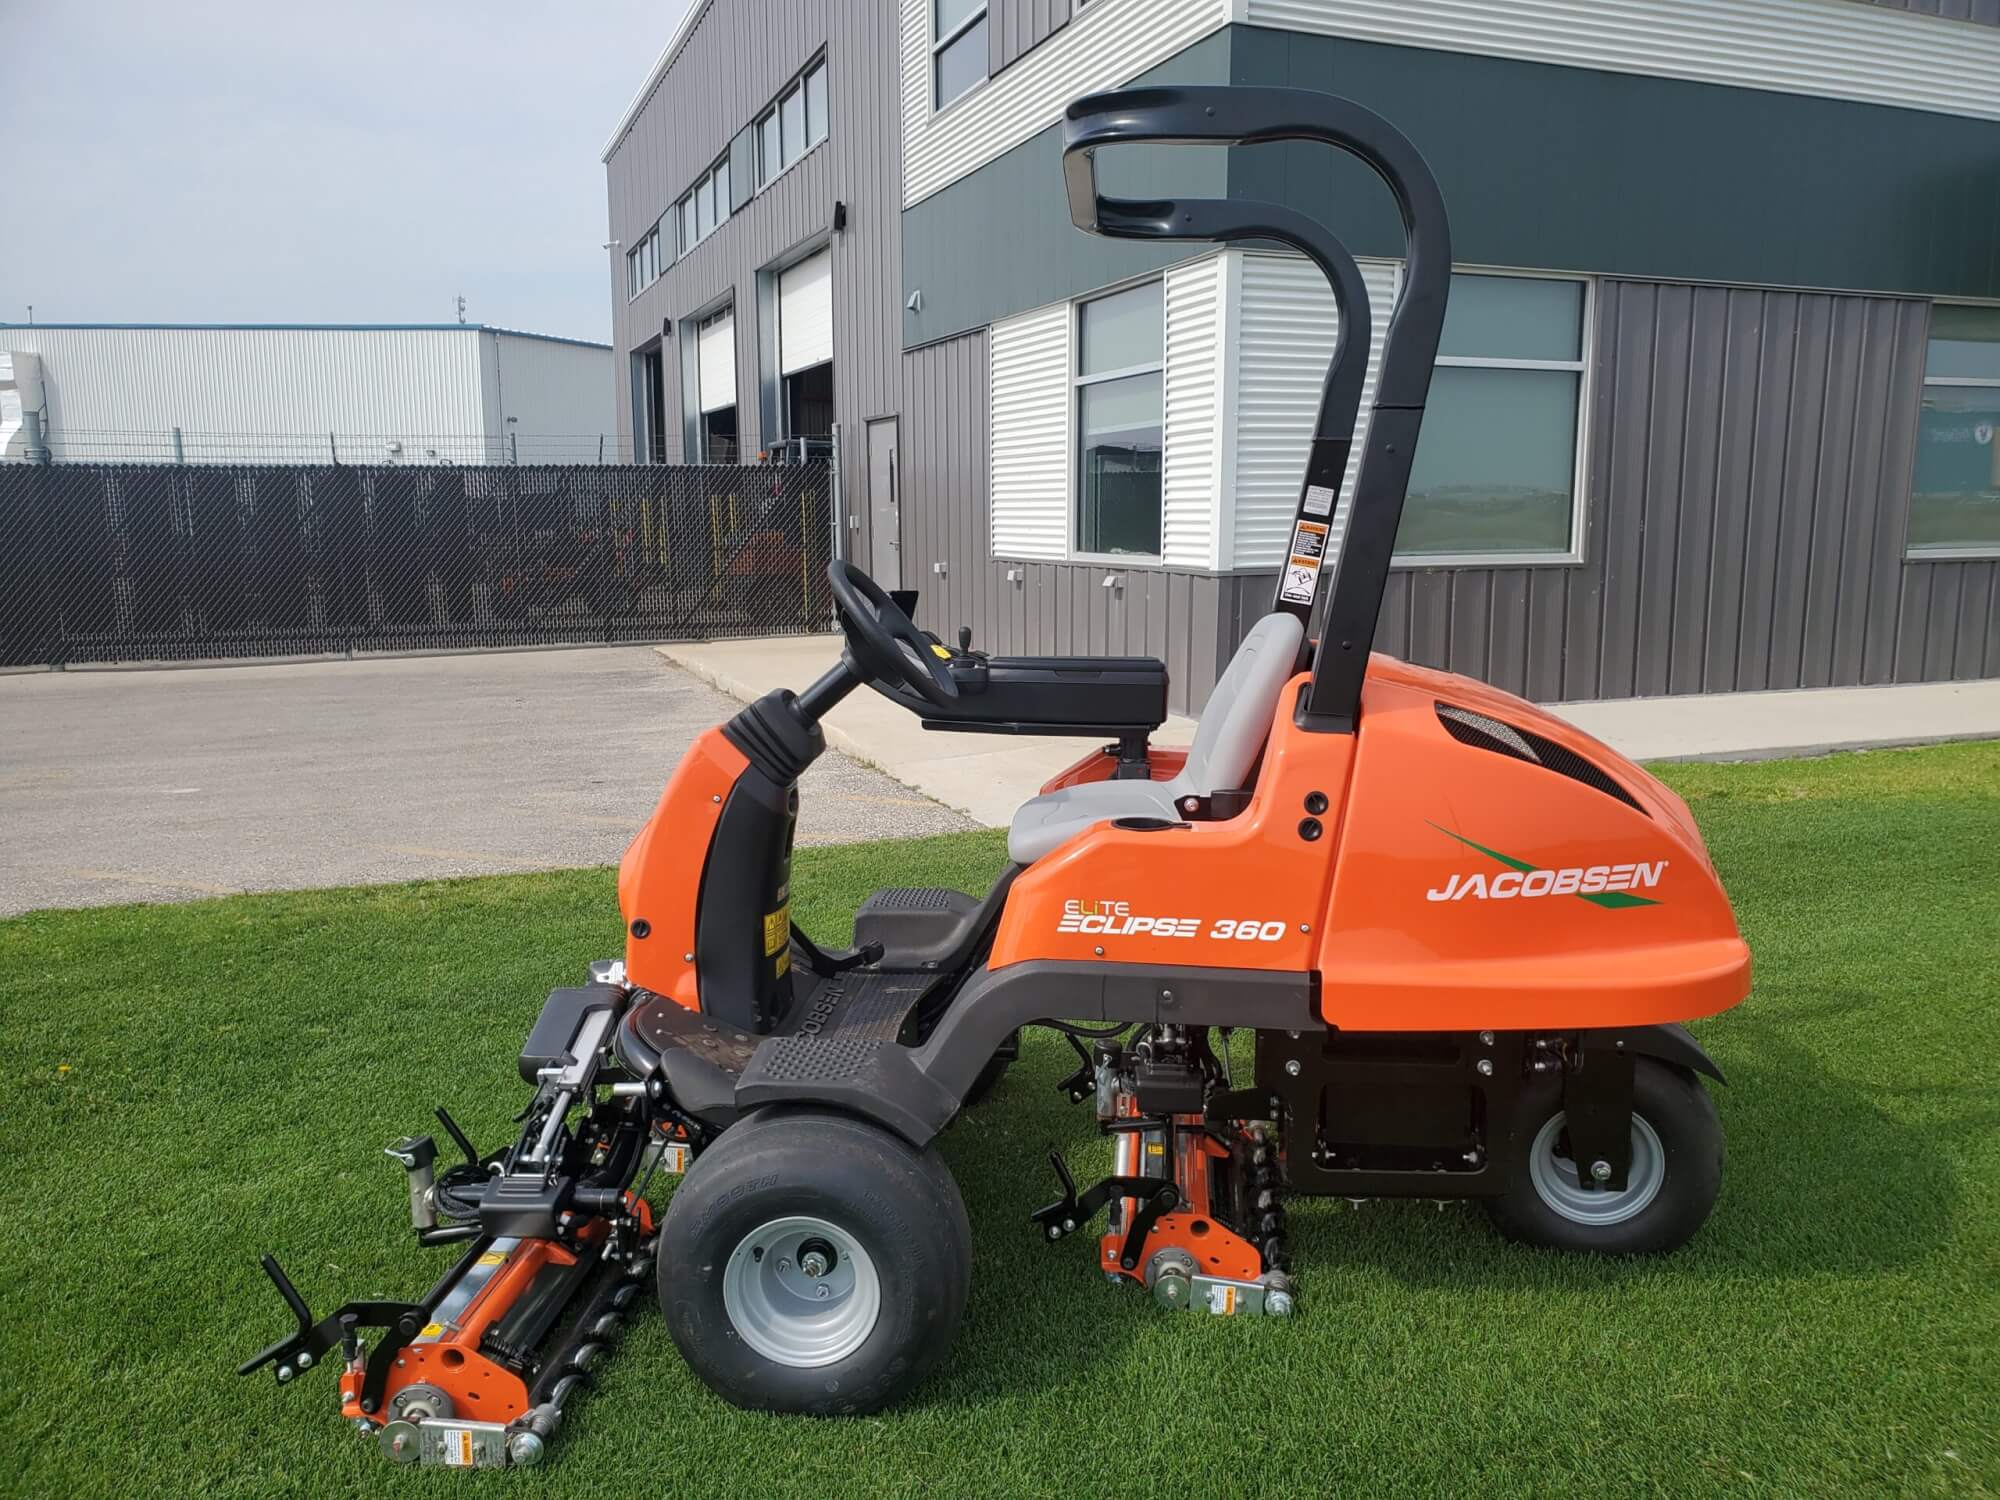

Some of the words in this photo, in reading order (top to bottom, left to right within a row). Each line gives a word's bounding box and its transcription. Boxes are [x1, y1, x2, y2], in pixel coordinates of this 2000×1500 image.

[1426, 861, 1665, 902] JACOBSEN
[1056, 914, 1202, 937] ECLIPSE
[1209, 919, 1287, 941] 360
